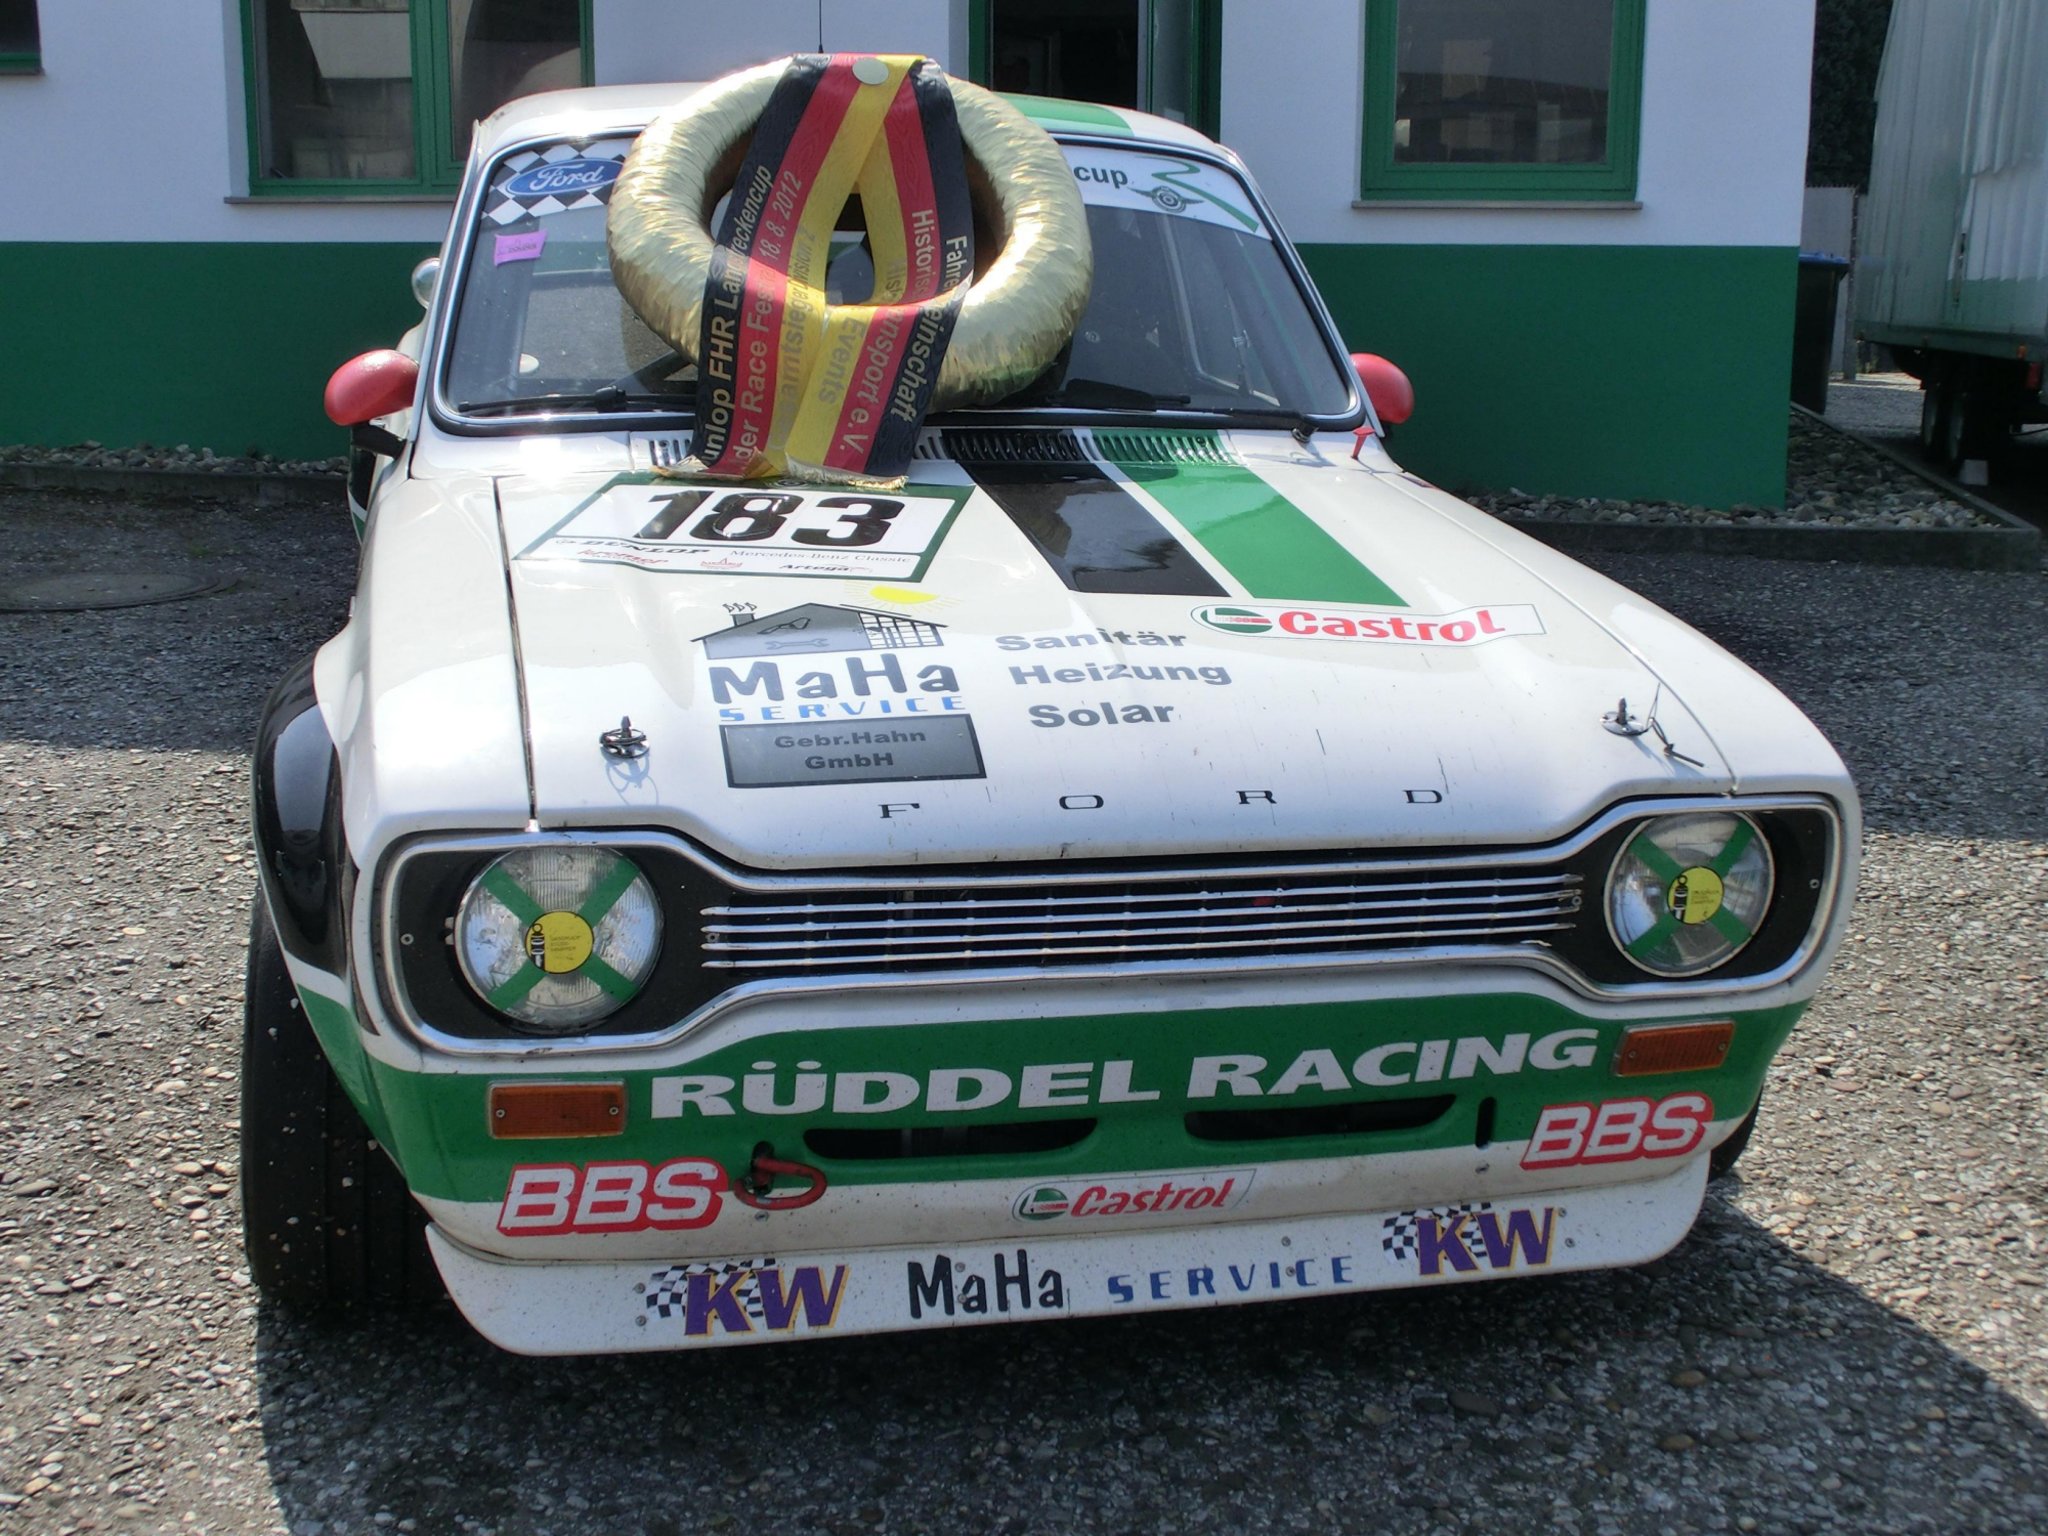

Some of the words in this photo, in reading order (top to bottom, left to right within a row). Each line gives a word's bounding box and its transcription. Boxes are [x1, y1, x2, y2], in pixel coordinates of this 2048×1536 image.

[530, 164, 604, 191] Ford
[773, 170, 803, 218] 2012
[1073, 165, 1129, 189] cup
[759, 239, 781, 260] 18.
[766, 219, 787, 239] 8.
[708, 316, 738, 381] FHR
[819, 317, 865, 405] Events
[740, 341, 767, 414] Race
[701, 388, 736, 466] unlop
[634, 490, 906, 547] 183
[995, 628, 1187, 651] Sanitär
[1278, 610, 1506, 643] Castrol
[708, 653, 960, 704] MaHa
[1008, 663, 1232, 686] Heizung
[719, 696, 966, 722] SERVICE
[1028, 702, 1175, 728] Solar
[774, 730, 927, 749] Gebr.Hahn
[805, 753, 894, 769] GmbH
[878, 789, 1443, 819] FORD
[651, 1060, 1160, 1119] RÜDDEL
[1186, 1028, 1599, 1098] RACING
[1527, 1093, 1708, 1163] BBS
[499, 1158, 722, 1231] BBS
[1070, 1178, 1236, 1217] Castrol
[1415, 1207, 1557, 1276] KW
[684, 1264, 850, 1336] KW
[907, 1249, 1064, 1319] MaHa
[1108, 1256, 1353, 1304] SERVICE
